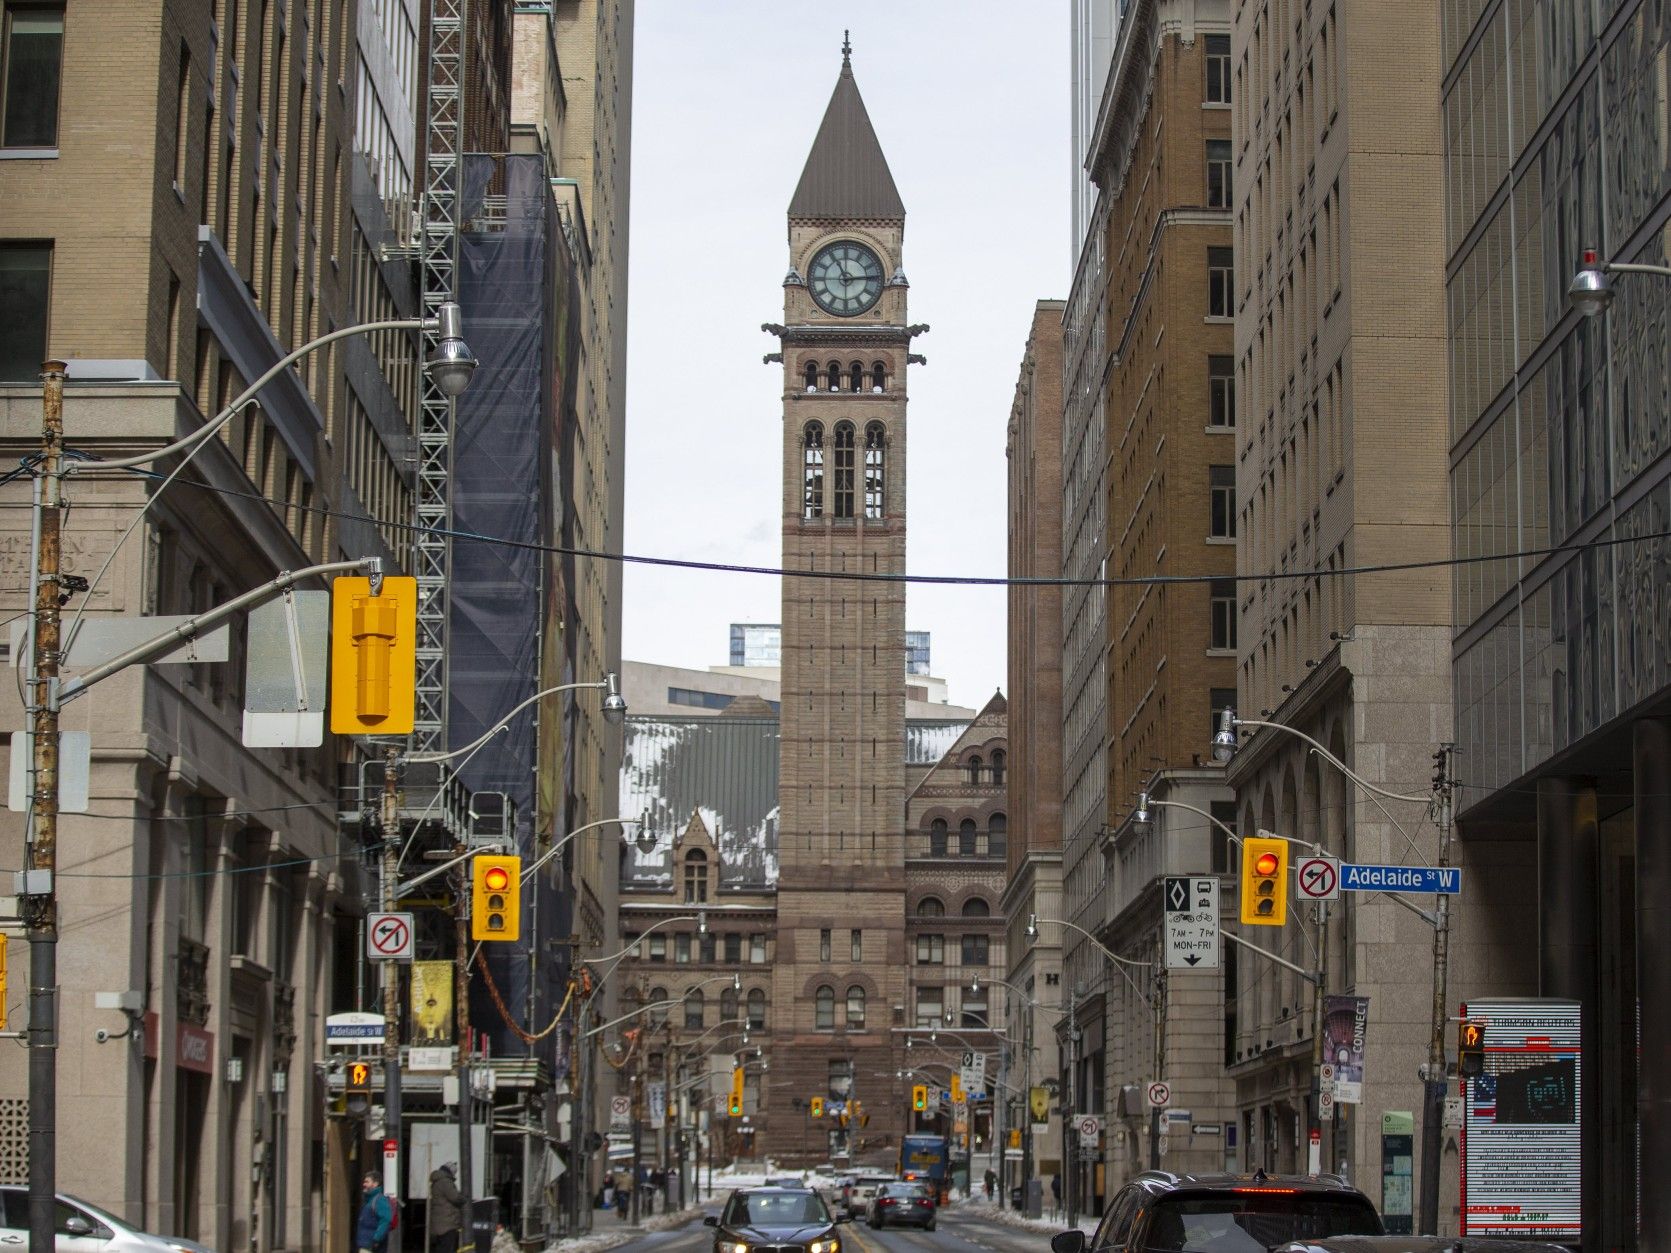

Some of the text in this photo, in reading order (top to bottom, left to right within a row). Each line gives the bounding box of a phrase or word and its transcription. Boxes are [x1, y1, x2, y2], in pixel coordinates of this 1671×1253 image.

[1347, 867, 1453, 888] Adelaide St W
[1173, 941, 1211, 950] MON-FRI
[331, 1026, 365, 1036] Adelaide
[1353, 1000, 1367, 1054] CONNECT
